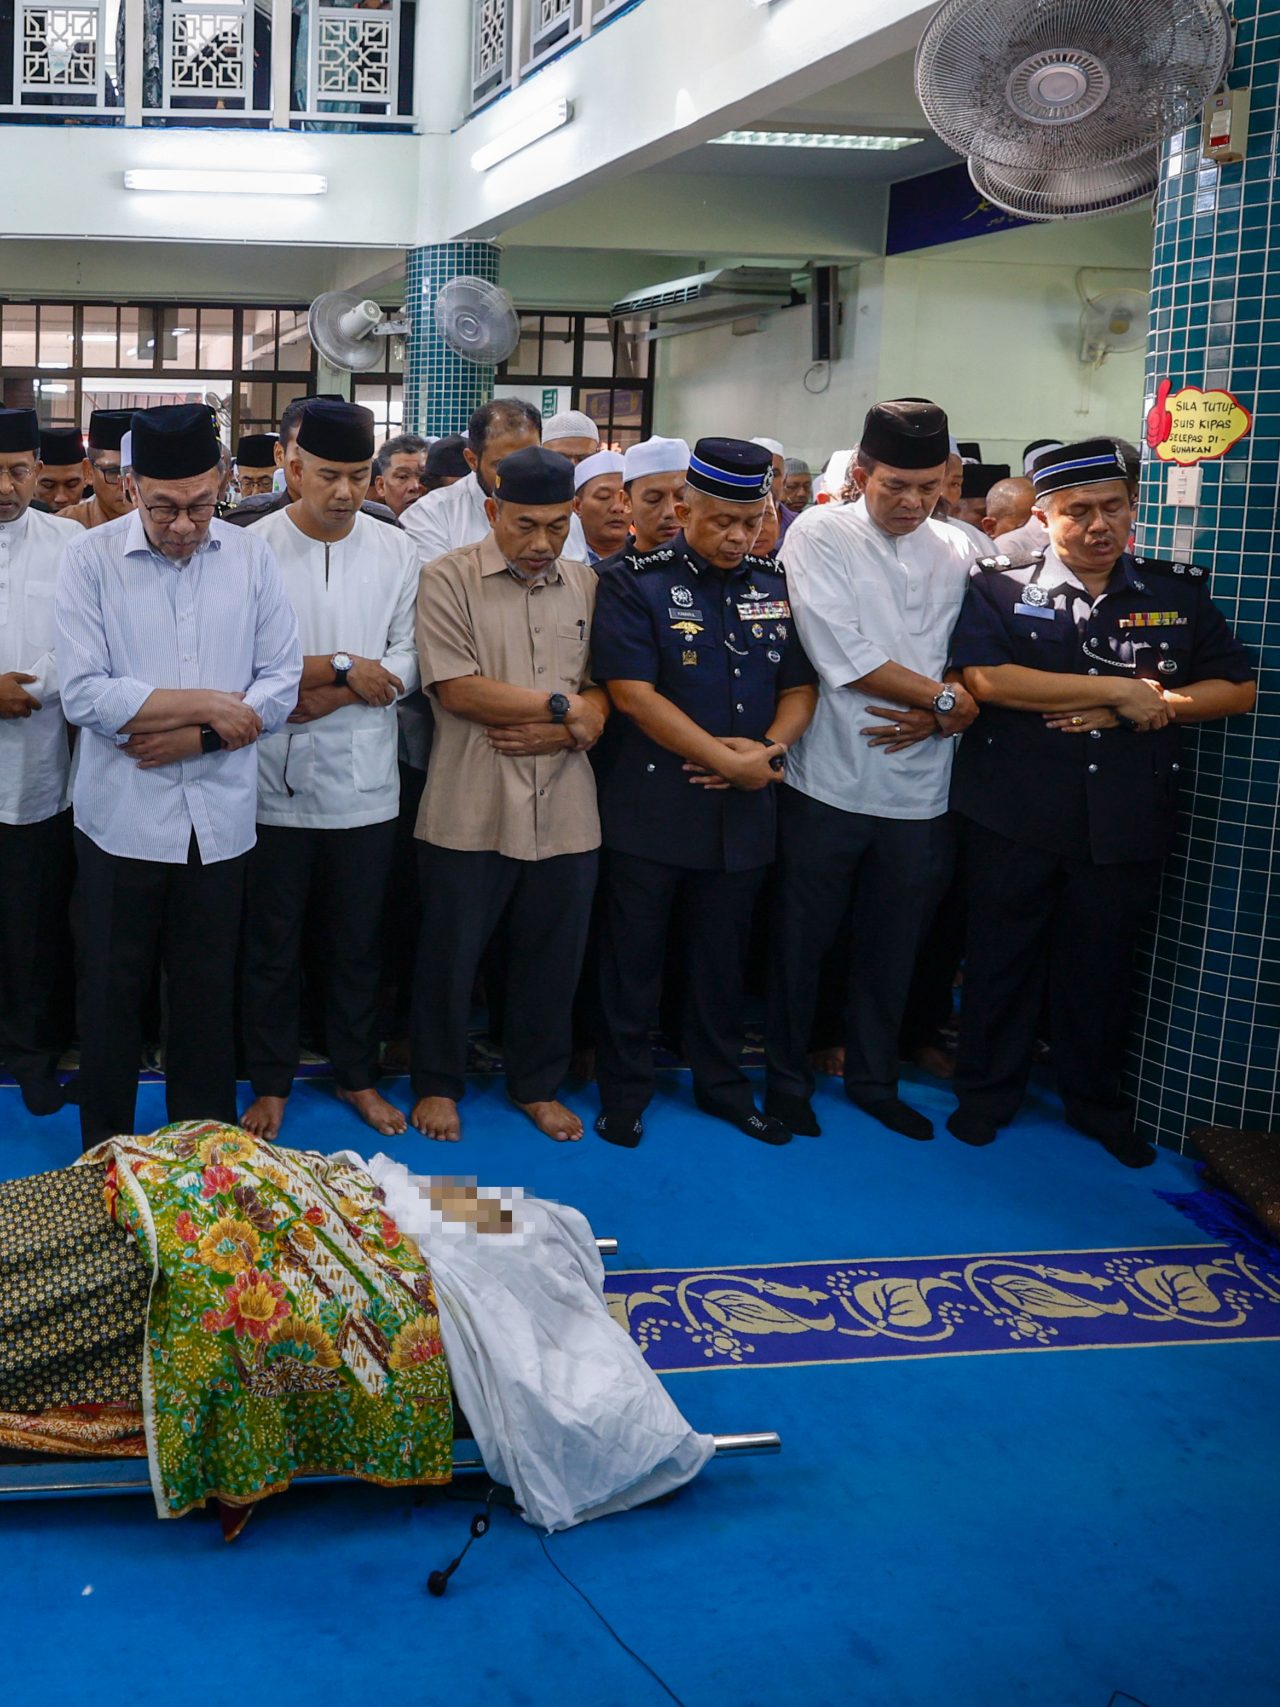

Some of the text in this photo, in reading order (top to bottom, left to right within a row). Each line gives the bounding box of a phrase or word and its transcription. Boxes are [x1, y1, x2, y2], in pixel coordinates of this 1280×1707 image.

[1176, 401, 1237, 415] SILA TUTUP
[1173, 419, 1232, 431] SUIS KIPAS
[1169, 433, 1203, 443] SELEPAS
[1171, 446, 1212, 454] GUNAKAN
